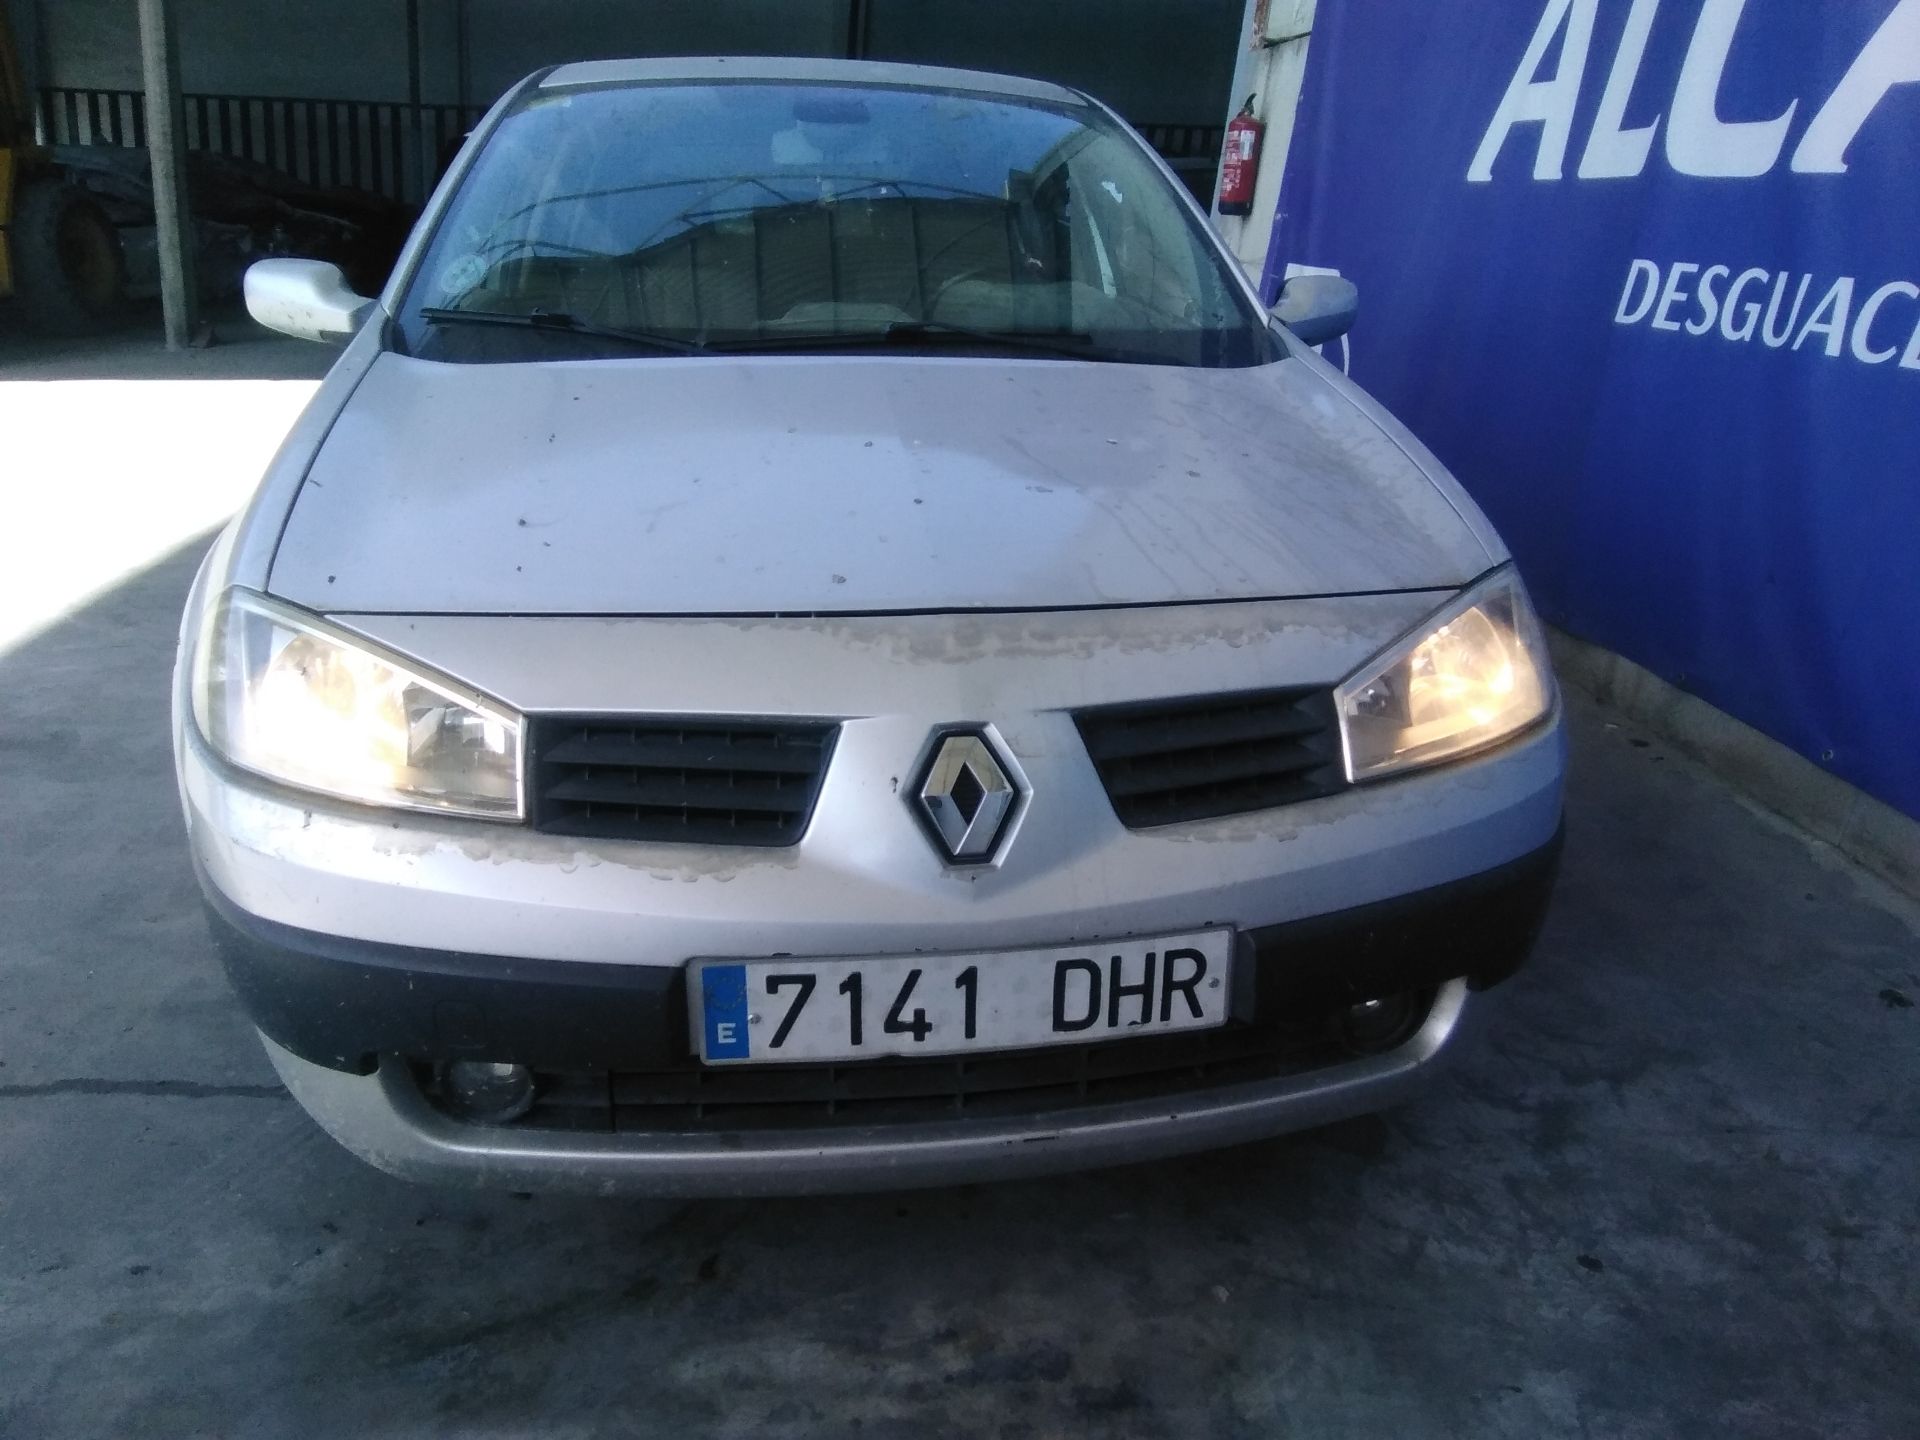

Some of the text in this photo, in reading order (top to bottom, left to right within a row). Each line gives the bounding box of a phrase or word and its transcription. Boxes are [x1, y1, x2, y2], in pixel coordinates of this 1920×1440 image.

[765, 948, 1208, 1048] 7141 DHR
[717, 1023, 737, 1044] E
